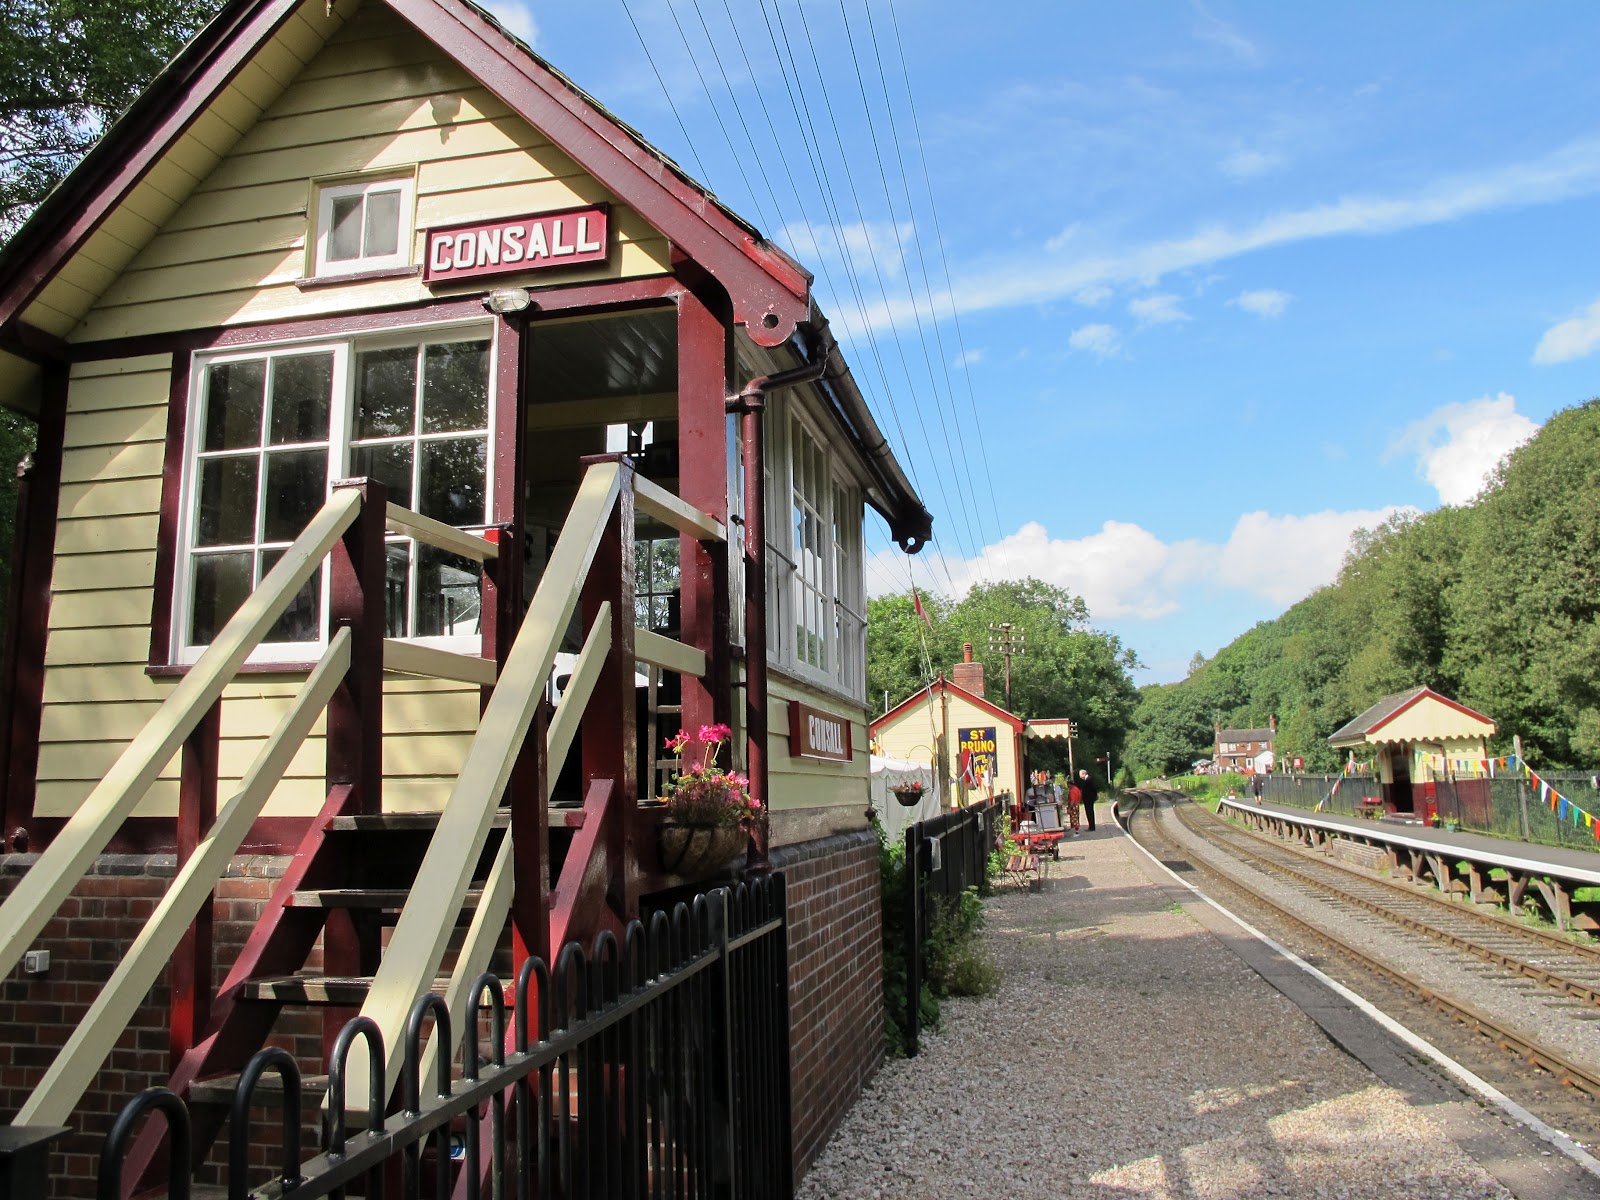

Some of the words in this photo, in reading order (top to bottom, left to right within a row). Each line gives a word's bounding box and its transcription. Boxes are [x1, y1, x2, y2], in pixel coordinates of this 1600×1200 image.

[430, 217, 600, 272] CONSALL
[808, 714, 843, 754] CONSALL
[961, 740, 995, 753] BRUNO
